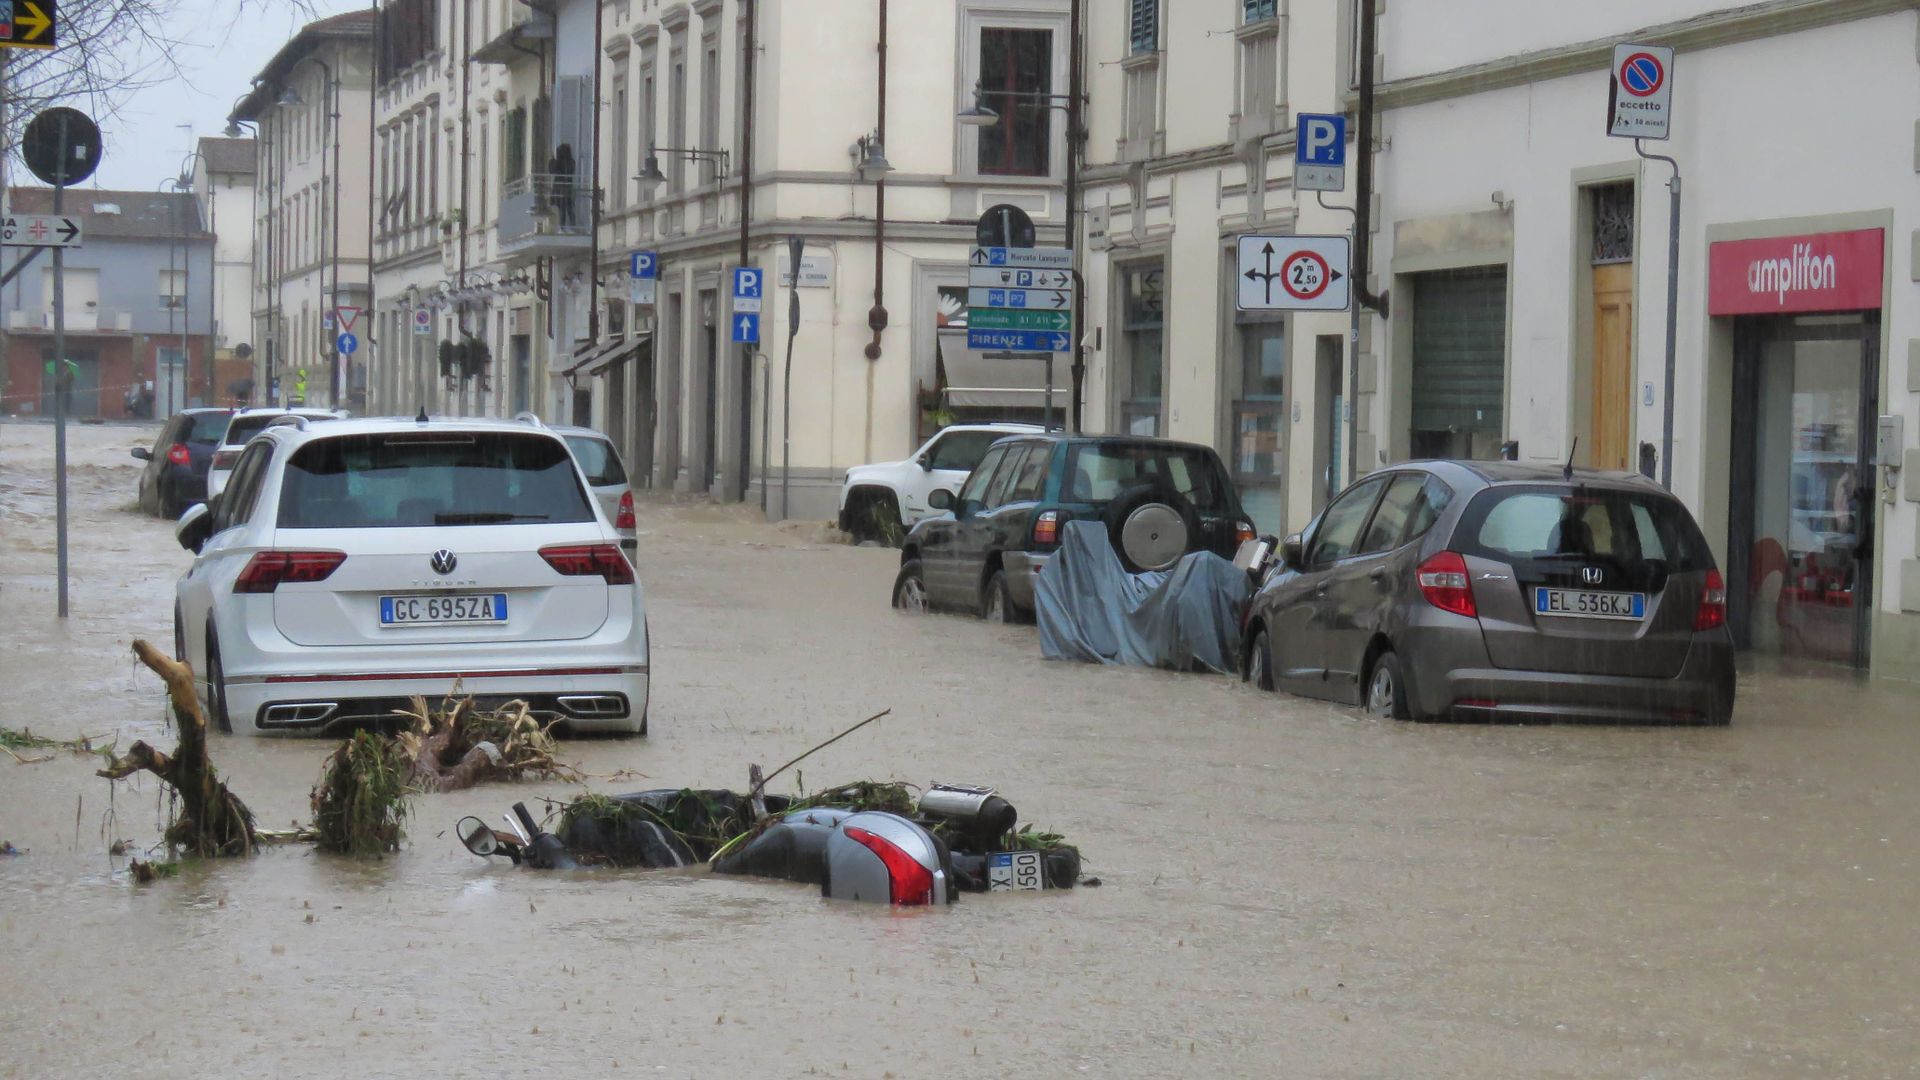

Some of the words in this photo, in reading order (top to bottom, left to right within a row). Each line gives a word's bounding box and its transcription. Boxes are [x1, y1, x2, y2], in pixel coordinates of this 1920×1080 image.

[1620, 101, 1661, 110] eccetto
[636, 254, 652, 275] P
[1748, 243, 1835, 305] amplifon
[972, 334, 1025, 346] FIRENZE
[395, 599, 420, 620] GC
[428, 598, 493, 619] 695ZA
[1549, 592, 1570, 611] EL
[1578, 593, 1632, 614] 536KJ
